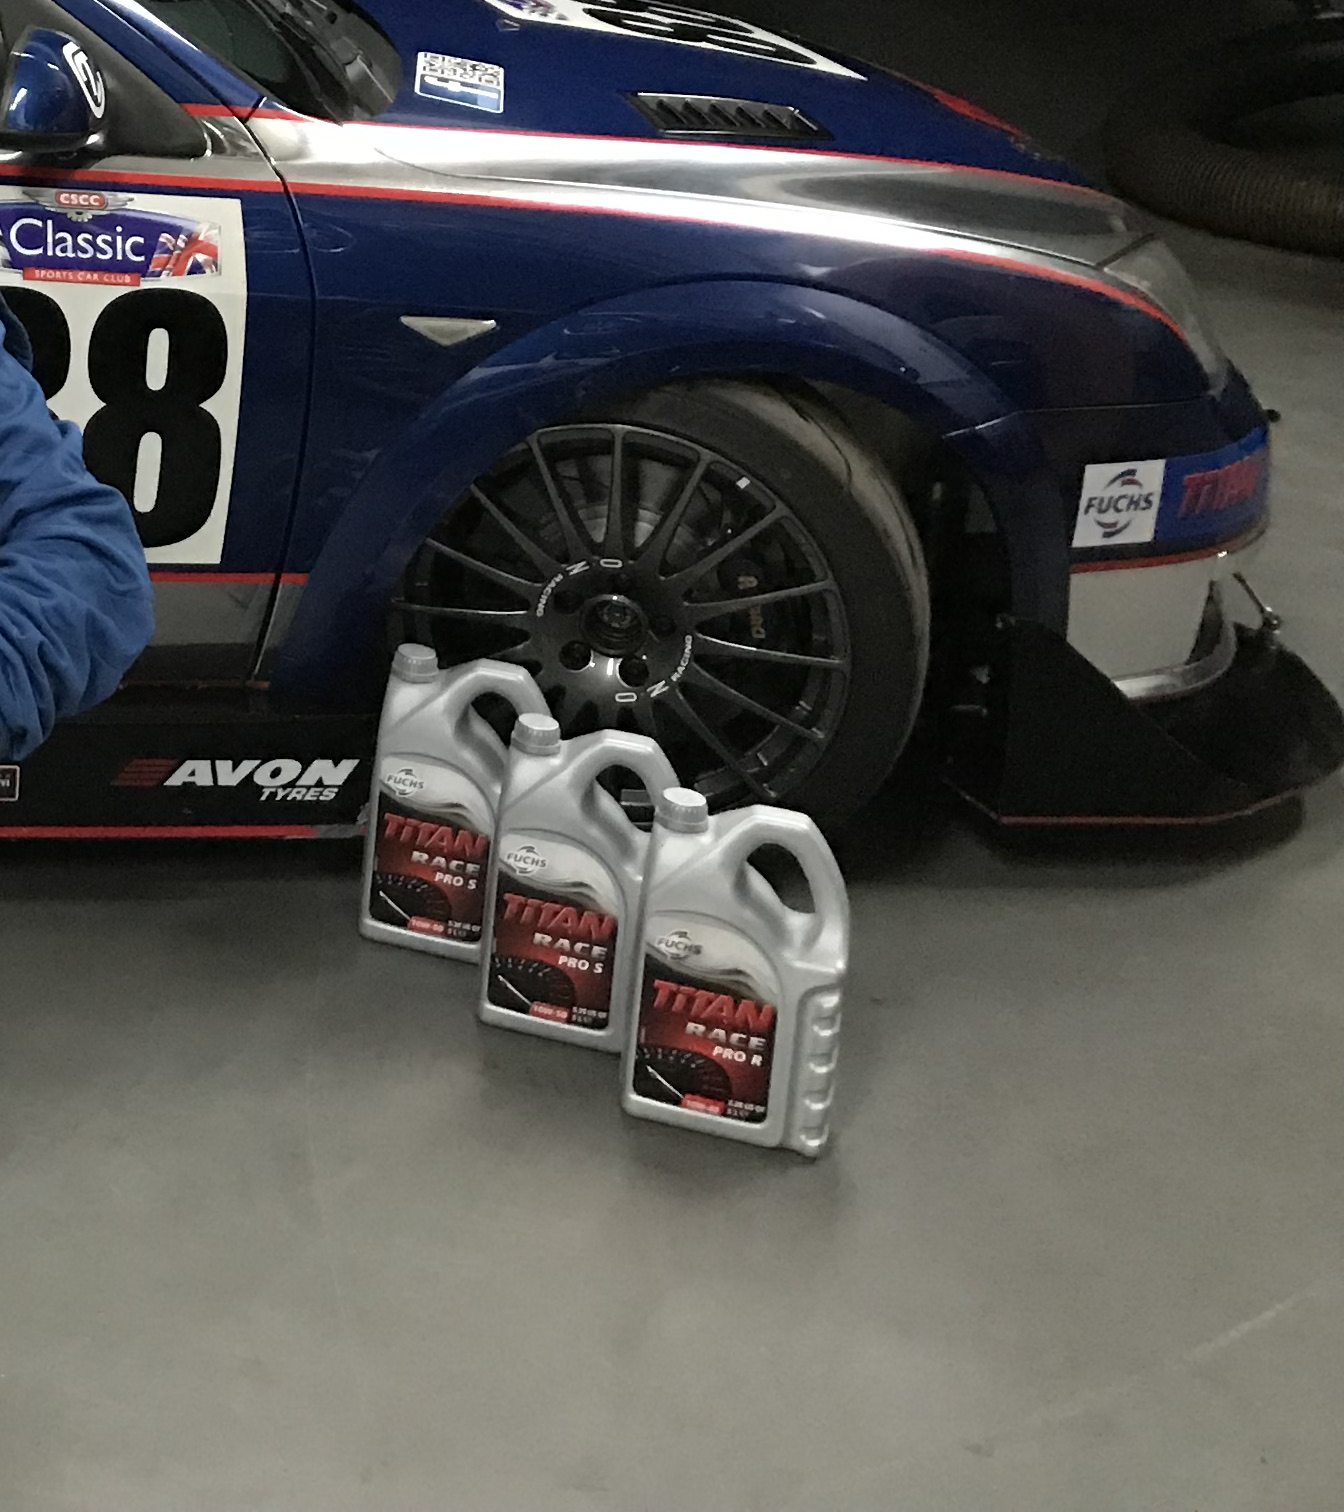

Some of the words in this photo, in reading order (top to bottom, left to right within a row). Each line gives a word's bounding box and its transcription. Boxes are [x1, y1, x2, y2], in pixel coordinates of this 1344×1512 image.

[58, 191, 102, 207] CSCC
[9, 217, 147, 263] Classic
[34, 268, 75, 282] SPORTS
[78, 271, 101, 283] CAR
[103, 273, 132, 285] CLUB
[1083, 492, 1154, 516] FUCHS
[163, 758, 360, 787] AVON
[386, 773, 425, 790] FUCHS
[259, 787, 339, 801] TYRES
[411, 850, 481, 876] RACE
[506, 851, 547, 869] FUCHS
[434, 872, 464, 887] PRO
[467, 878, 478, 890] S
[532, 931, 608, 961] RACE
[656, 938, 703, 955] FUCHS
[558, 955, 590, 971] PRO
[593, 962, 604, 974] S
[685, 1021, 767, 1051] RACE
[713, 1045, 747, 1063] PRO
[750, 1053, 763, 1067] R
